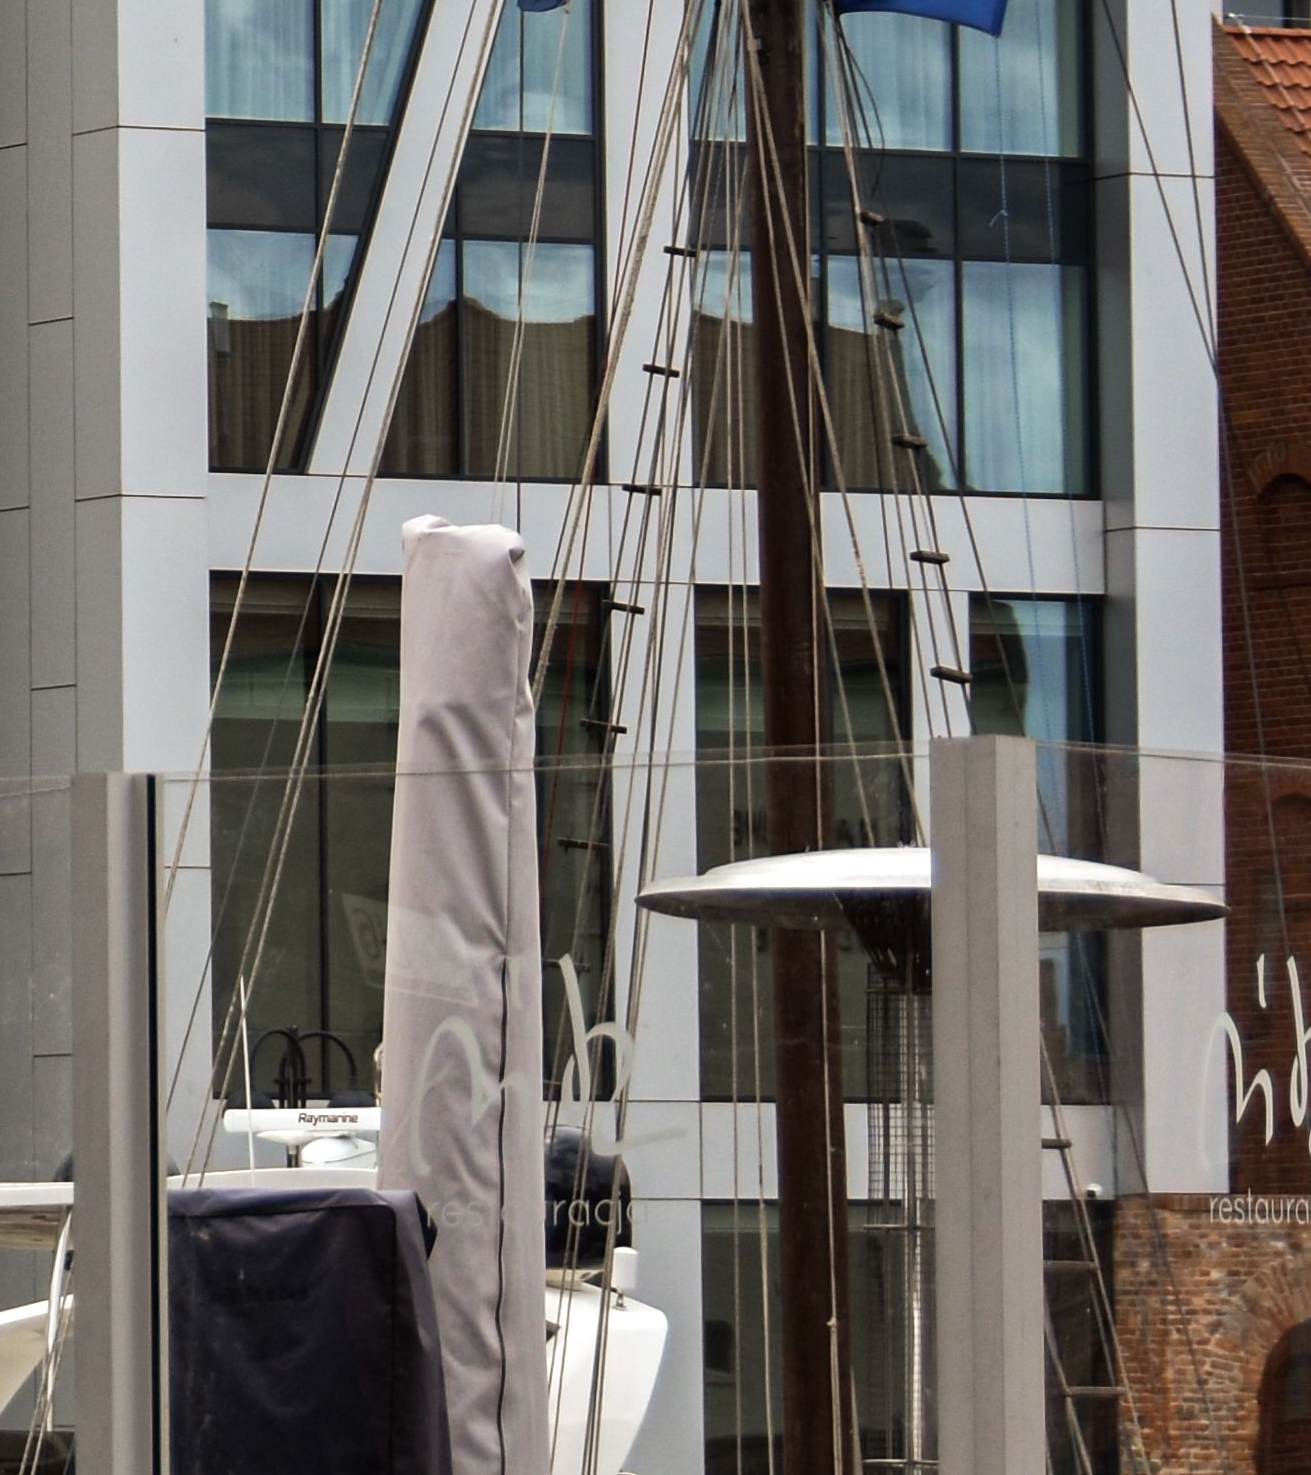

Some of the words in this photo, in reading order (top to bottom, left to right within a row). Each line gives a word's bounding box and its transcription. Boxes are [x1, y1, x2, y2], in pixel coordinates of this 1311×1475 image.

[298, 1112, 359, 1126] Raymarine
[426, 1190, 648, 1235] restracja
[1209, 1187, 1311, 1225] restaura
